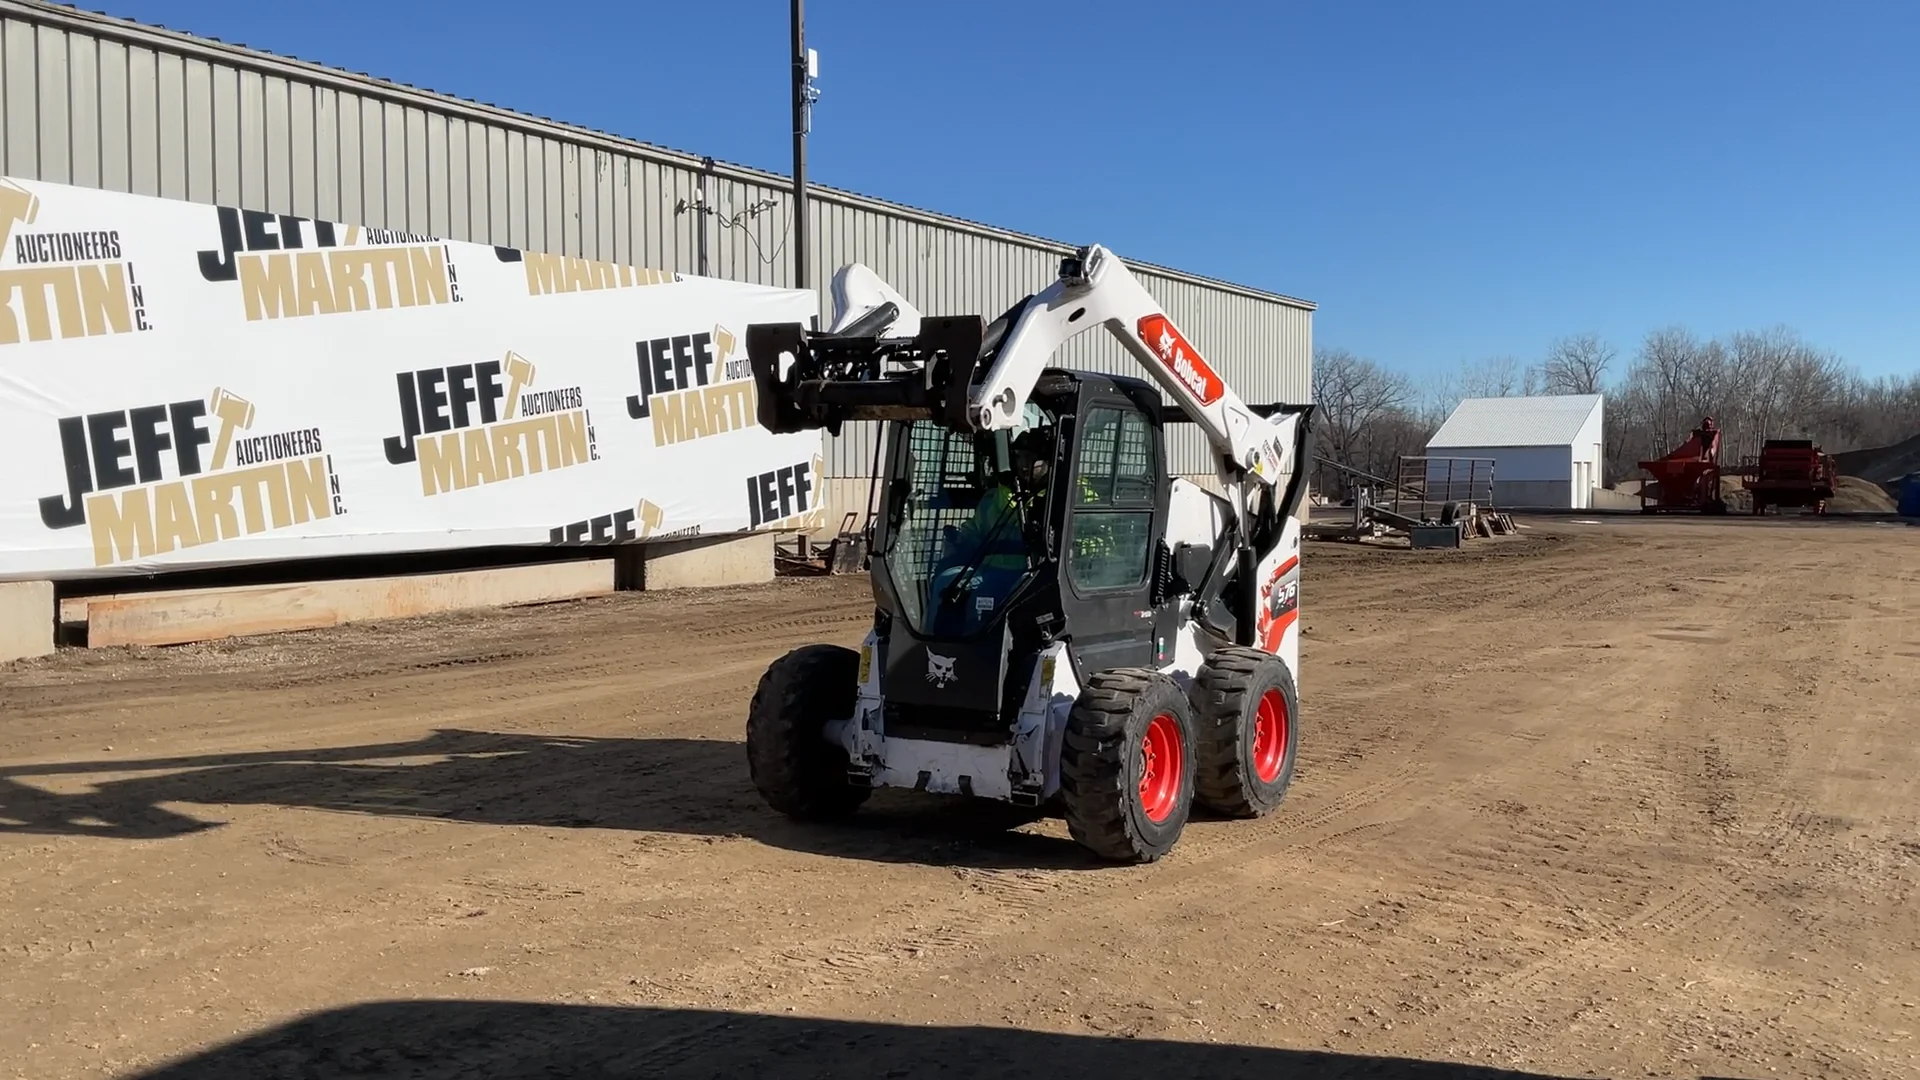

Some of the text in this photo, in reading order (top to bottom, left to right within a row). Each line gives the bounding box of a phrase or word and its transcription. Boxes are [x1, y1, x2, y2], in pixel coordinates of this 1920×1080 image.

[15, 230, 121, 264] AUCTIONEERS
[238, 245, 449, 321] MARTIN
[521, 386, 583, 417] AUCTIONEERS
[626, 332, 713, 419] JEFF
[726, 359, 755, 381] AUCTIO
[1174, 347, 1207, 402] Bobcat
[235, 427, 322, 466] AUCTIONEERS
[383, 360, 504, 465] JEFF
[650, 380, 758, 447] MARTI
[38, 399, 211, 530] JEFF
[416, 410, 589, 497] MARTIN
[86, 456, 331, 567] MARTIN
